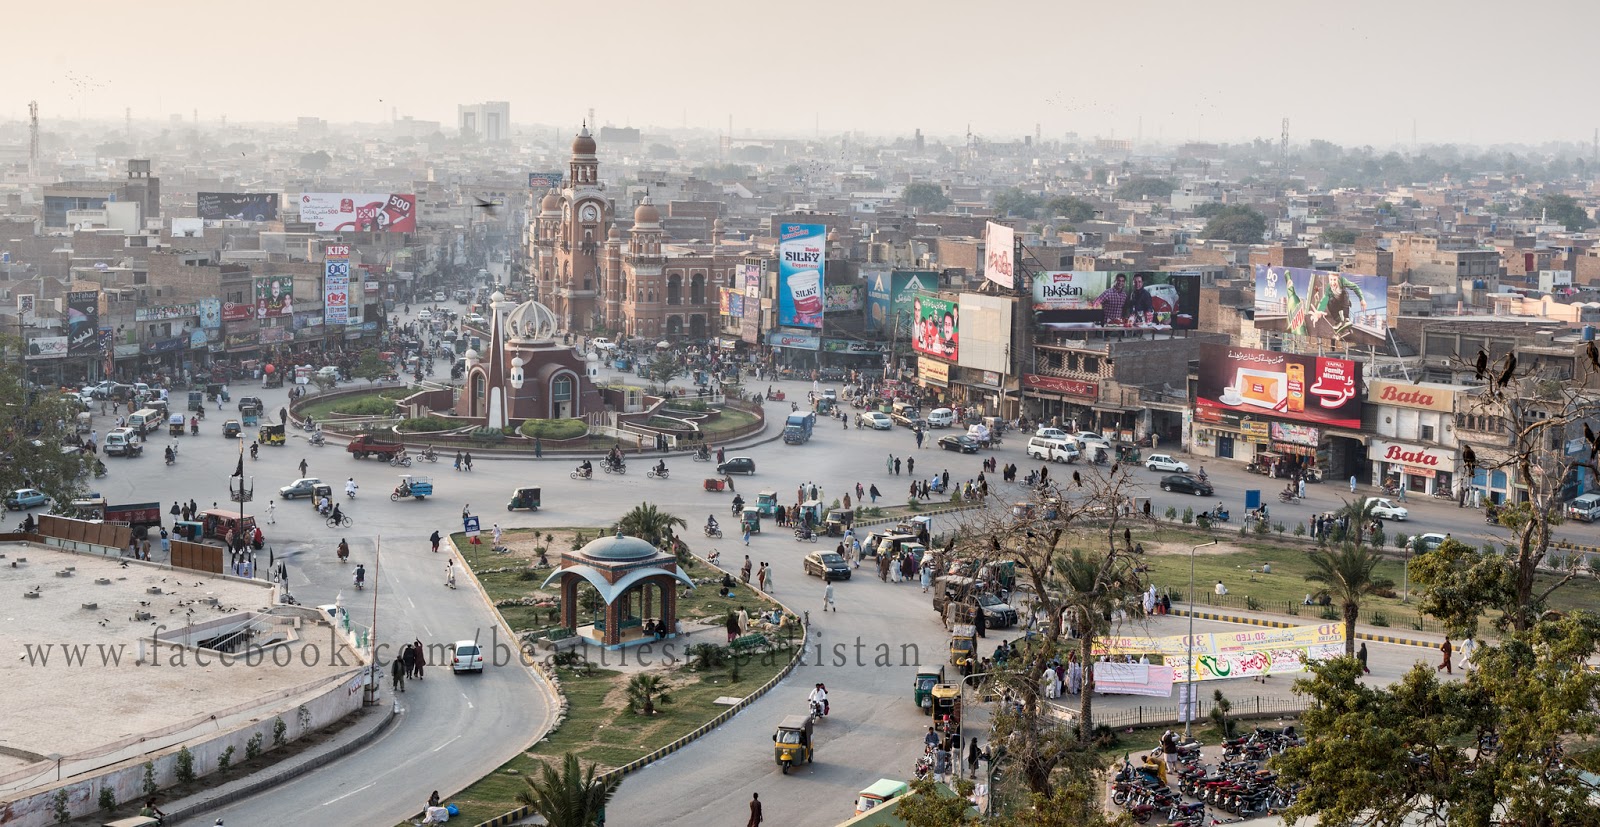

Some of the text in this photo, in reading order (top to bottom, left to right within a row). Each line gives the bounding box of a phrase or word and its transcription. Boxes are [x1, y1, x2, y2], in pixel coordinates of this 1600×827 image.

[390, 195, 410, 211] 500
[327, 246, 349, 255] KIPS
[785, 251, 820, 263] SILKY
[70, 292, 96, 300] Al-Fahad
[795, 286, 817, 298] SILKY
[1043, 284, 1083, 298] Pakistan
[1264, 287, 1278, 298] DEW
[1324, 366, 1344, 375] Family
[1322, 373, 1346, 381] Mixture
[1380, 386, 1435, 406] Bata
[1384, 445, 1439, 466] Bata
